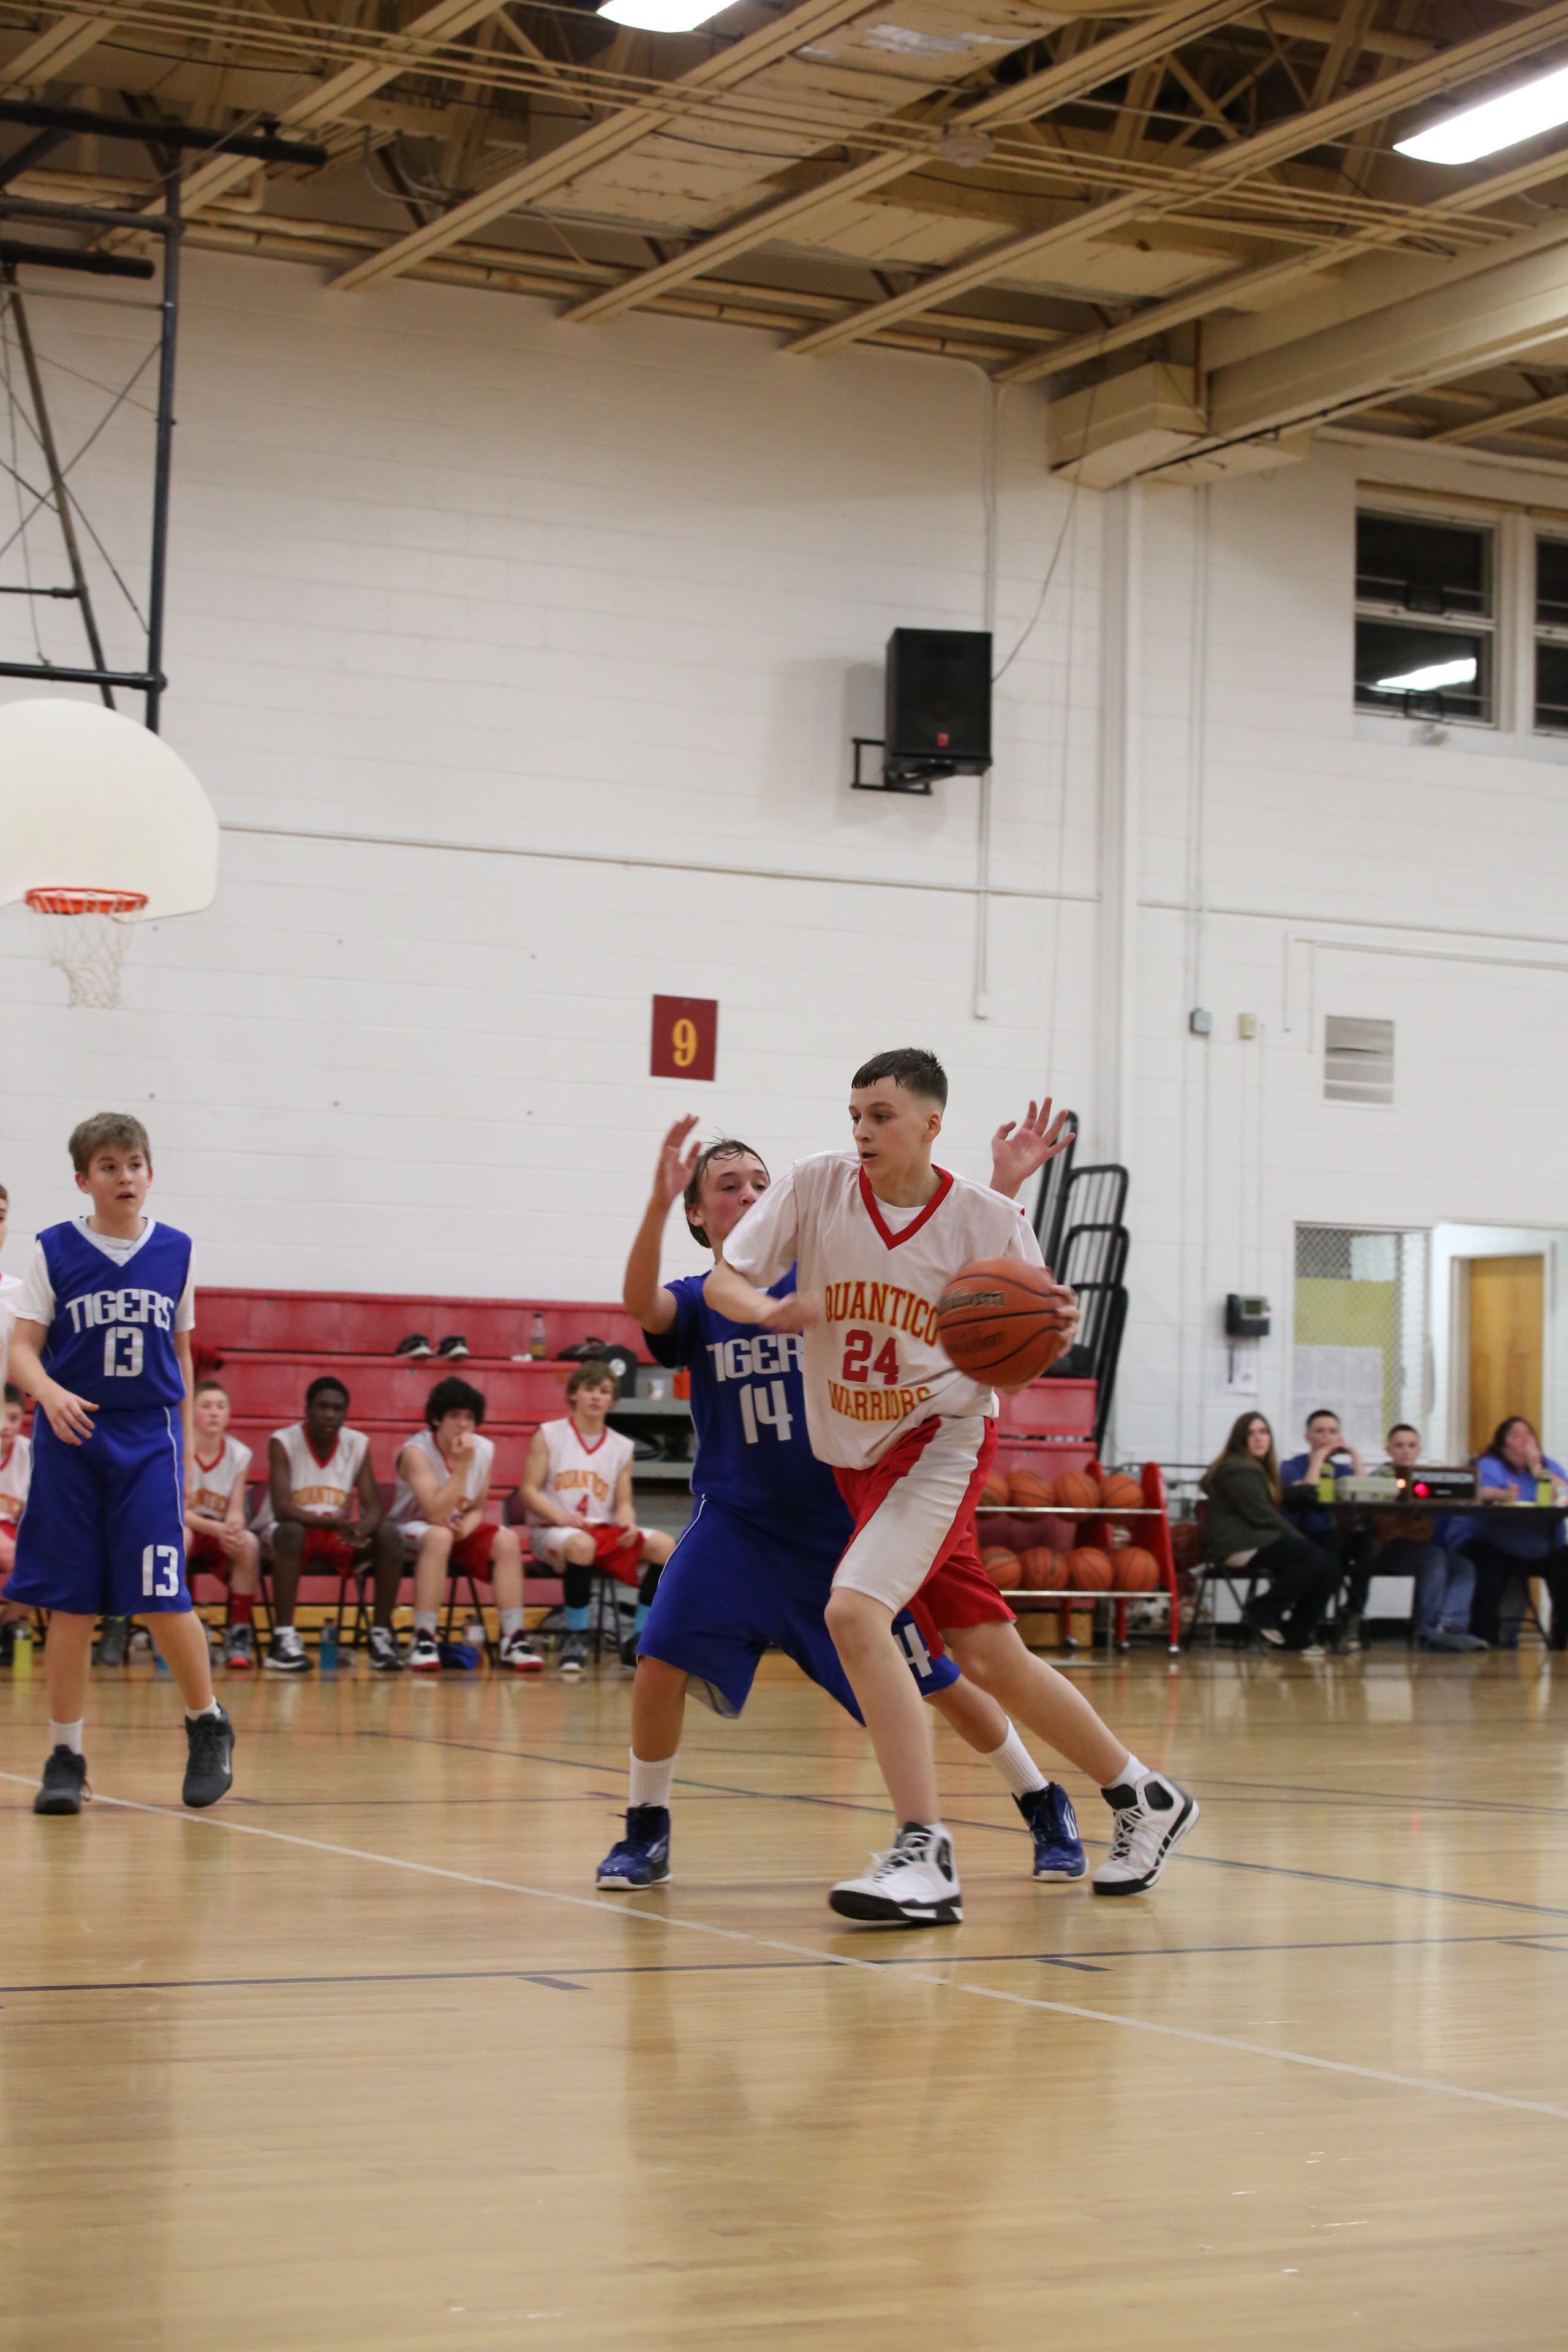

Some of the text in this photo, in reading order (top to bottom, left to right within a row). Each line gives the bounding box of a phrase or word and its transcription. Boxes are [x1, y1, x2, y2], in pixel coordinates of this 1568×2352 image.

[672, 1017, 698, 1068] 9
[65, 1287, 175, 1334] TIGERS
[104, 1325, 145, 1378] 13
[842, 1328, 899, 1386] 24
[739, 1379, 794, 1444] 14
[142, 1544, 179, 1597] 13
